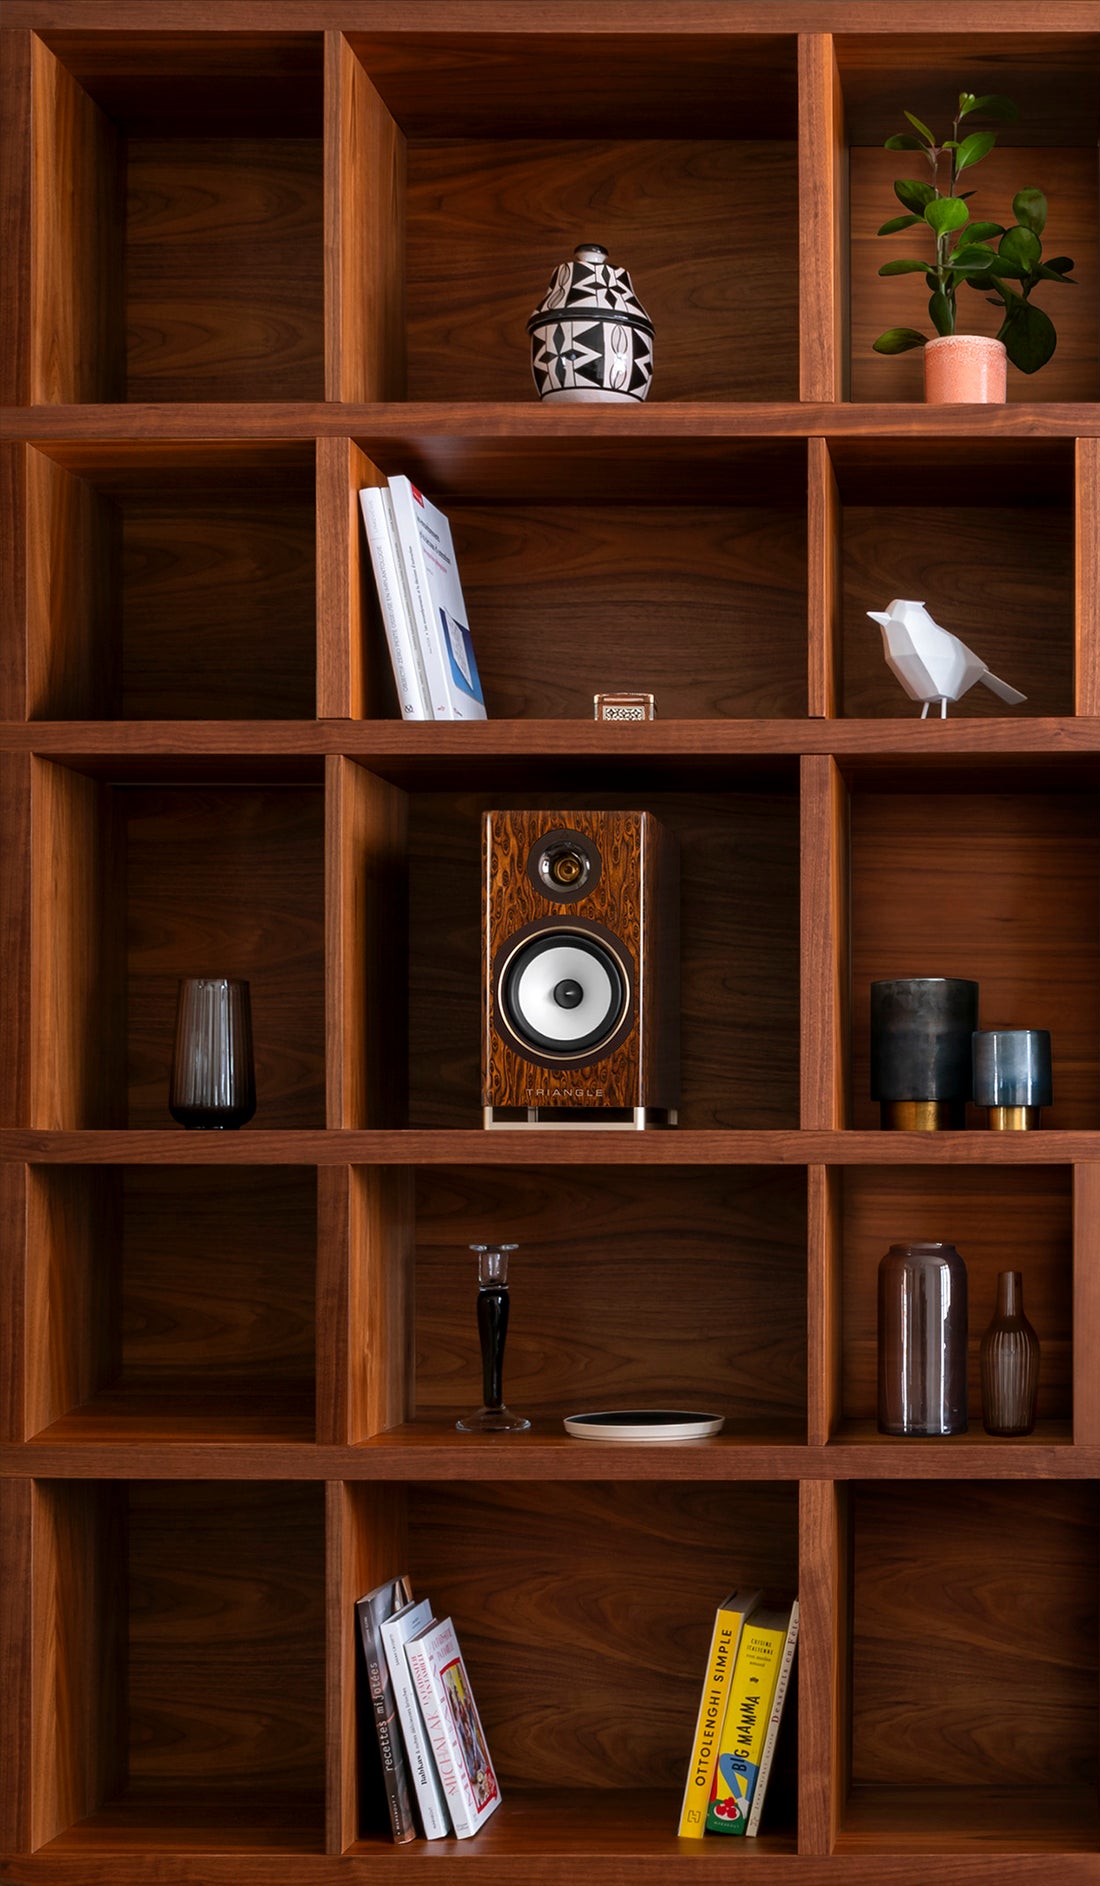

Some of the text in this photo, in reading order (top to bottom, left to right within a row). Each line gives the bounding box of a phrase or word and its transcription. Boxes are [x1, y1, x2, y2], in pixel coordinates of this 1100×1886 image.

[526, 1088, 604, 1097] TRIANGLE
[370, 1662, 394, 1772] recettes mijotées
[695, 1629, 733, 1786] OTTOLENGHI SIMPLE
[771, 1666, 788, 1724] Desserts
[786, 1650, 793, 1663] en
[414, 1754, 428, 1785] Babkas
[427, 1710, 456, 1796] MICHALAK
[730, 1696, 760, 1772] BIG MAMMA
